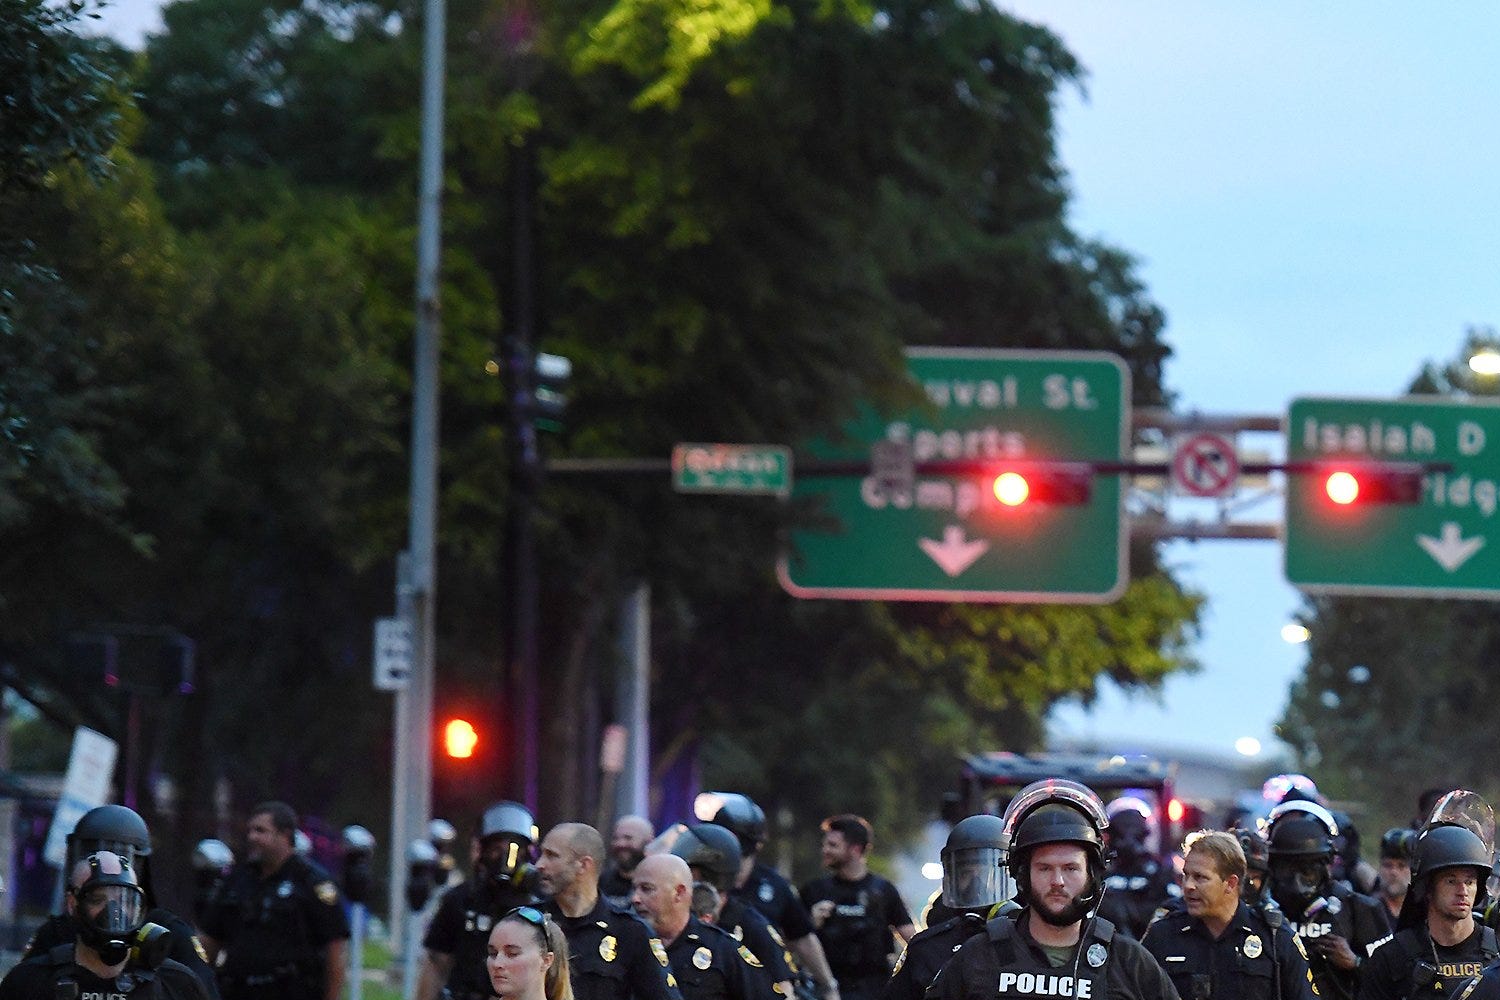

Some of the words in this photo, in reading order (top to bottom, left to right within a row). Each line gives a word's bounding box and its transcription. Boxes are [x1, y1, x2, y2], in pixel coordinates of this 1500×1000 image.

[1303, 417, 1436, 454] Isaiah
[1457, 421, 1486, 456] D
[998, 973, 1092, 999] POLICE
